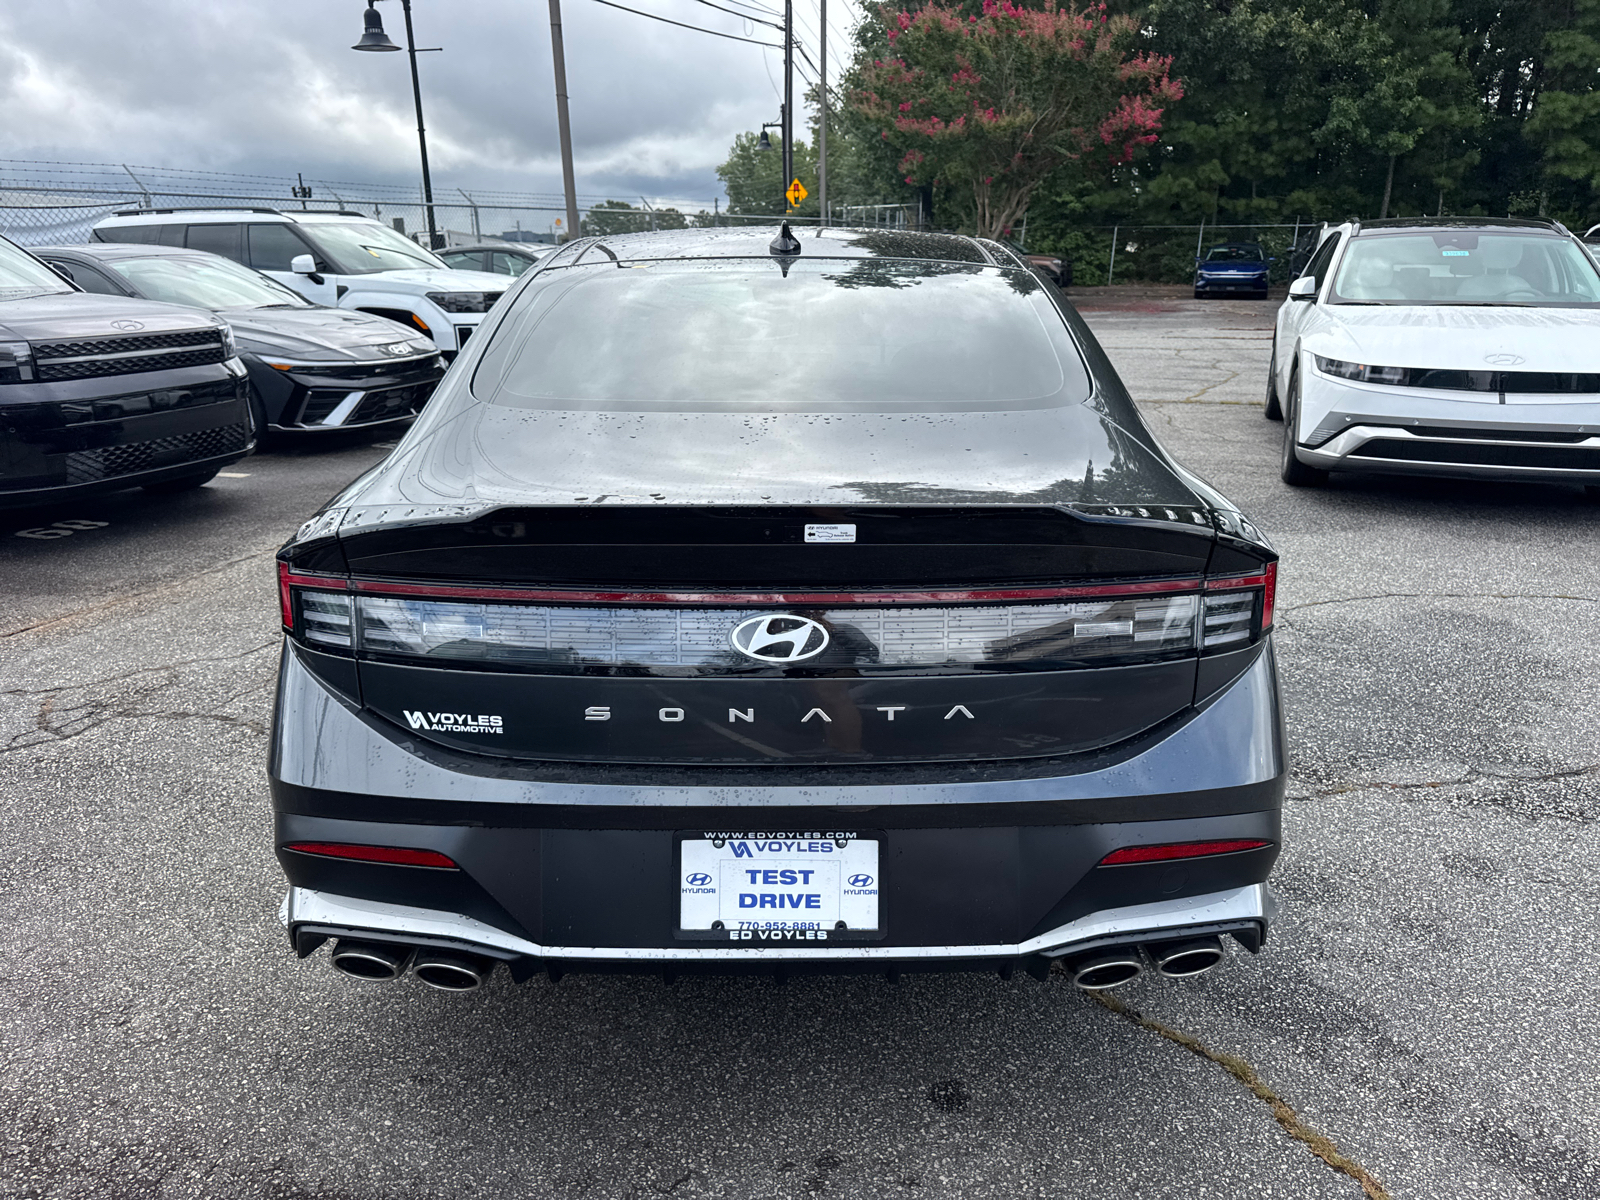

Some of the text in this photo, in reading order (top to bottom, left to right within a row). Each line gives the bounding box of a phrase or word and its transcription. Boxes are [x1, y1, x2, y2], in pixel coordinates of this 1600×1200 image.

[427, 712, 503, 726] VOYLES
[584, 704, 975, 723] SONATA
[431, 723, 504, 734] AUTOMOTIVE
[703, 831, 857, 839] WWW.EDVOYLES.COM
[754, 841, 834, 853] VOYLES
[745, 869, 815, 885] TEST
[738, 893, 822, 909] DRIVE
[738, 921, 821, 930] 770-952-8881
[729, 930, 828, 940] ED VOYLES
